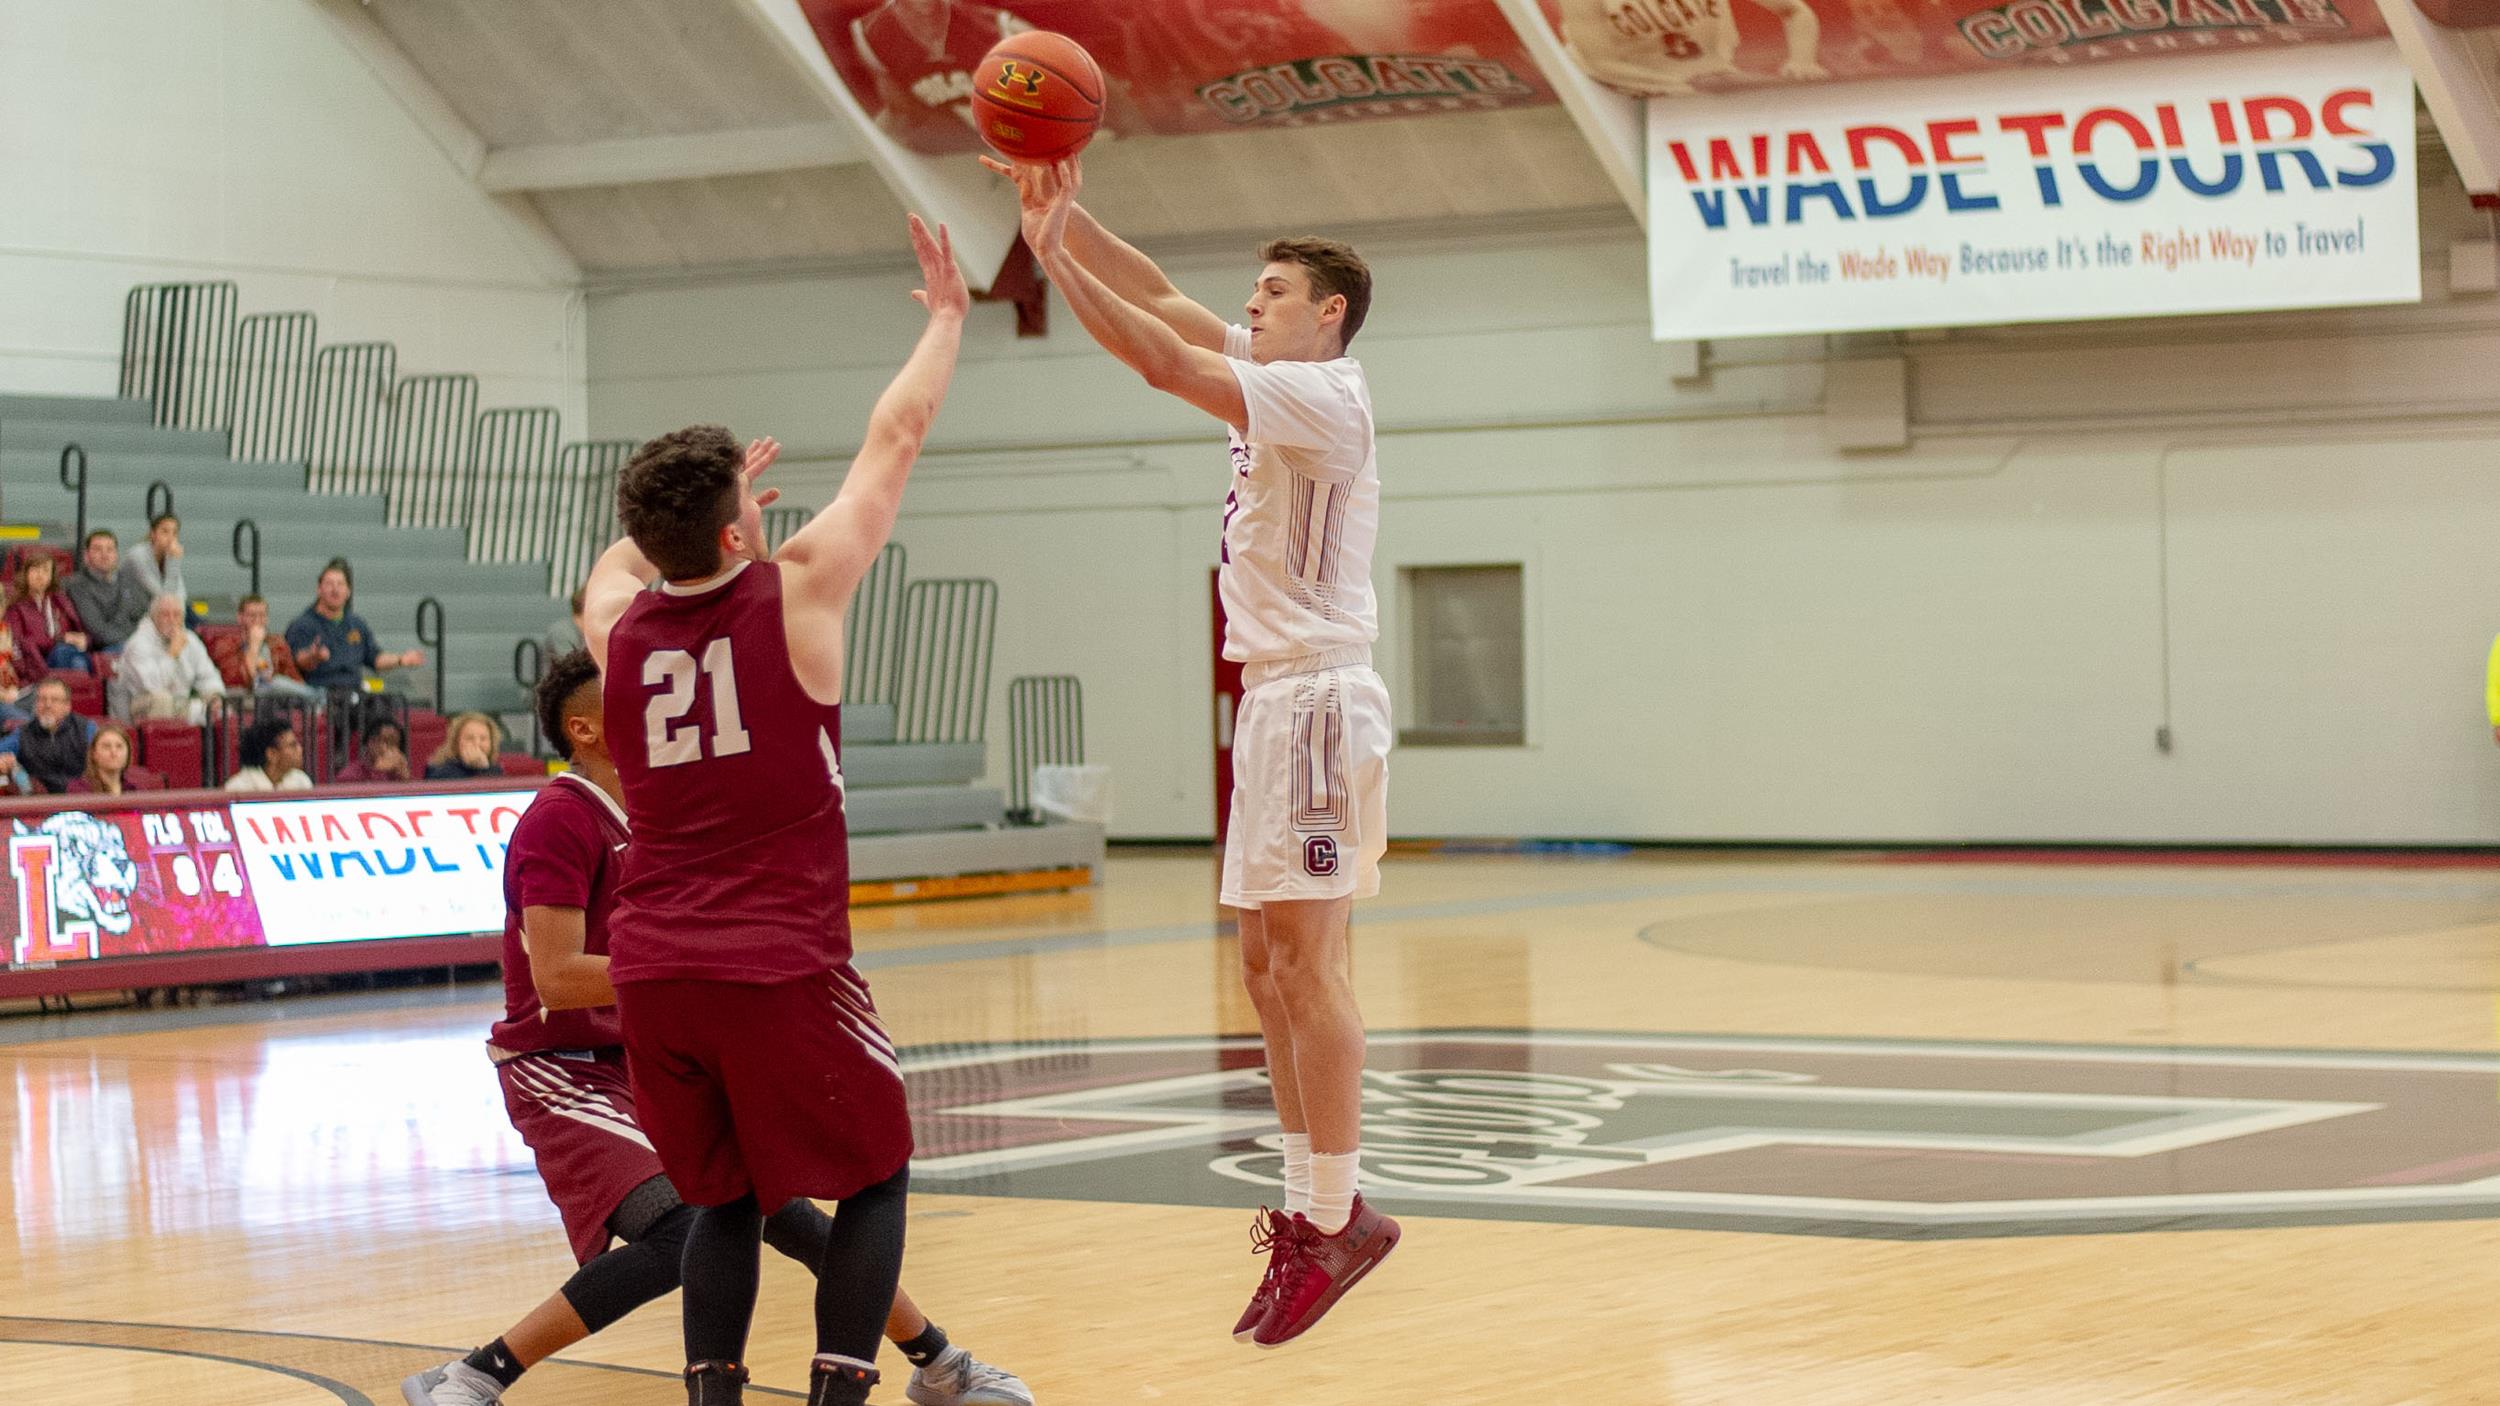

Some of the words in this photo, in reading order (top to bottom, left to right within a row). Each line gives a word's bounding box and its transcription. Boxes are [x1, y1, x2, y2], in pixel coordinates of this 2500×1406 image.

[1960, 0, 2350, 59] COLGATE
[1200, 55, 1537, 124] COLGATE
[1668, 118, 2001, 230] WADE
[1998, 87, 2396, 207] TOURS
[1730, 253, 1790, 289] Travel
[1796, 249, 1831, 283] the
[1838, 244, 1897, 281] Wade
[1904, 244, 1951, 282] Way
[1959, 241, 2049, 274] Because
[2056, 236, 2090, 270] It's
[2097, 231, 2133, 265] the
[2141, 226, 2200, 271] Right
[2208, 228, 2258, 268] Way
[2265, 230, 2287, 259] to
[2296, 215, 2365, 256] Travel
[643, 636, 751, 769] 21
[212, 852, 243, 897] 4
[247, 810, 460, 881] WADE
[1303, 835, 1338, 876] C
[9, 834, 99, 964] L
